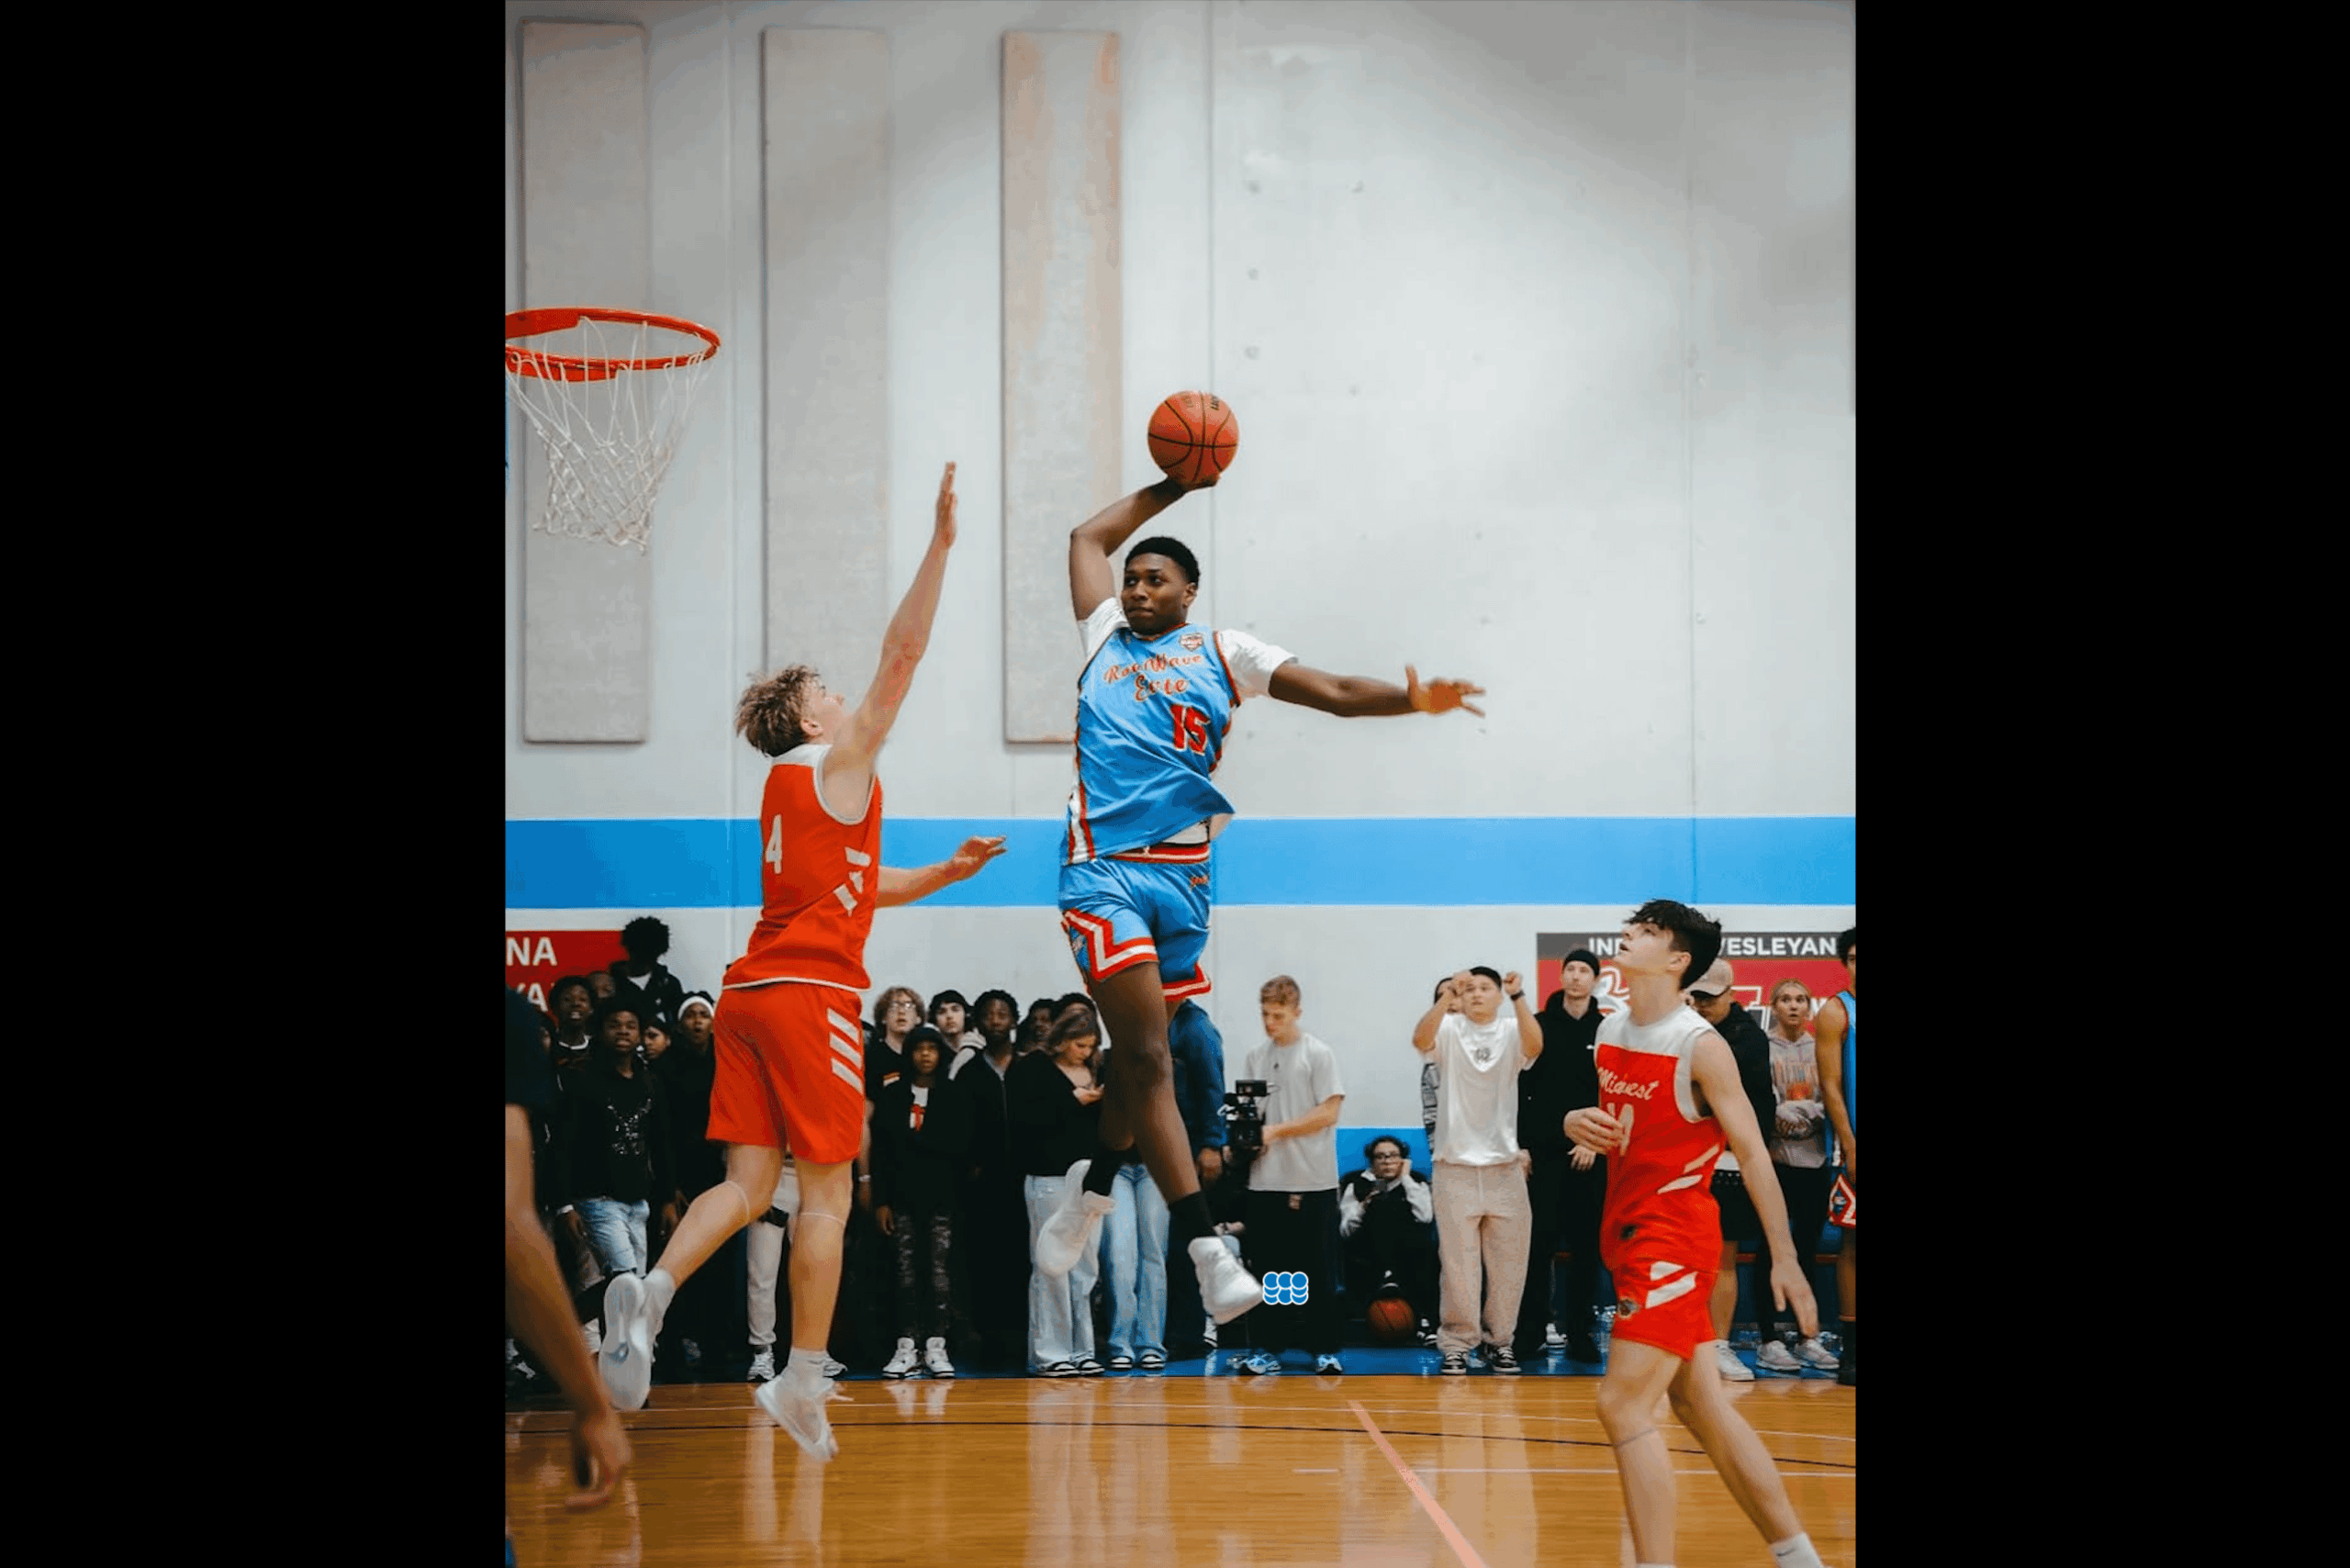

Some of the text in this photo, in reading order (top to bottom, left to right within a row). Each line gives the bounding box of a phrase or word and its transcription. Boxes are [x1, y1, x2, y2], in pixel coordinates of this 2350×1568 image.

[1170, 703, 1210, 756] 15
[765, 813, 782, 874] 4
[506, 936, 557, 966] NA
